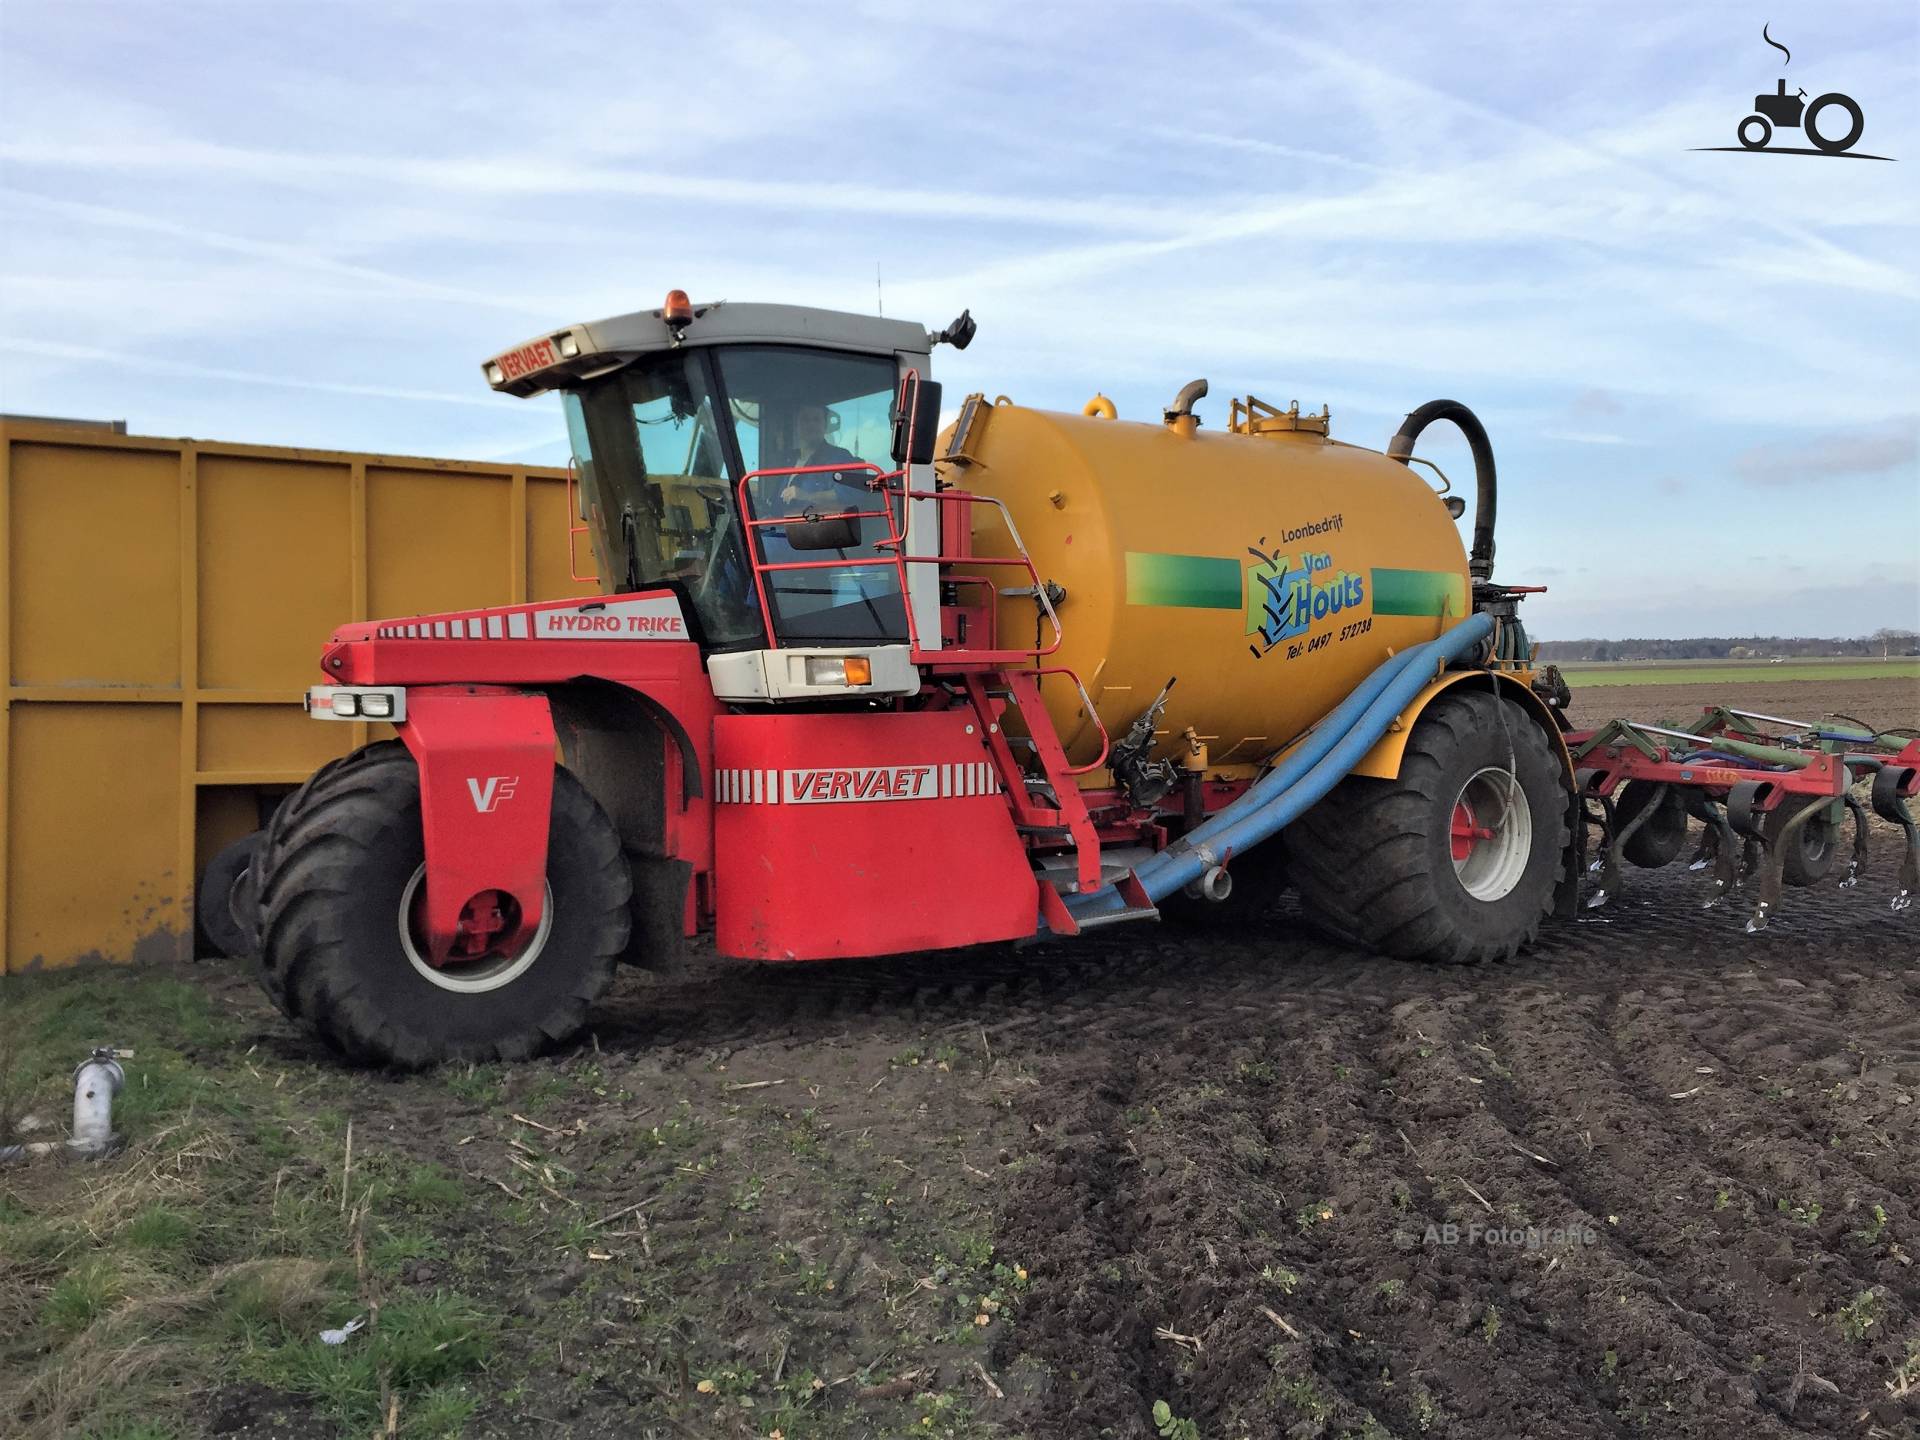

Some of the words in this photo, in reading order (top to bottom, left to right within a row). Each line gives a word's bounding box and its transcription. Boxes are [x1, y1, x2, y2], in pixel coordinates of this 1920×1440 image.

[496, 338, 555, 379] VERVAET
[1281, 513, 1343, 543] Loonbedrijf
[1302, 552, 1332, 574] Van
[1292, 573, 1364, 628] Houts
[548, 615, 621, 632] HYDRO
[626, 615, 682, 633] TRIKE
[1286, 642, 1304, 661] Tel:
[1307, 632, 1333, 653] 0497
[1339, 617, 1373, 642] 572738
[791, 767, 930, 800] VERVAET
